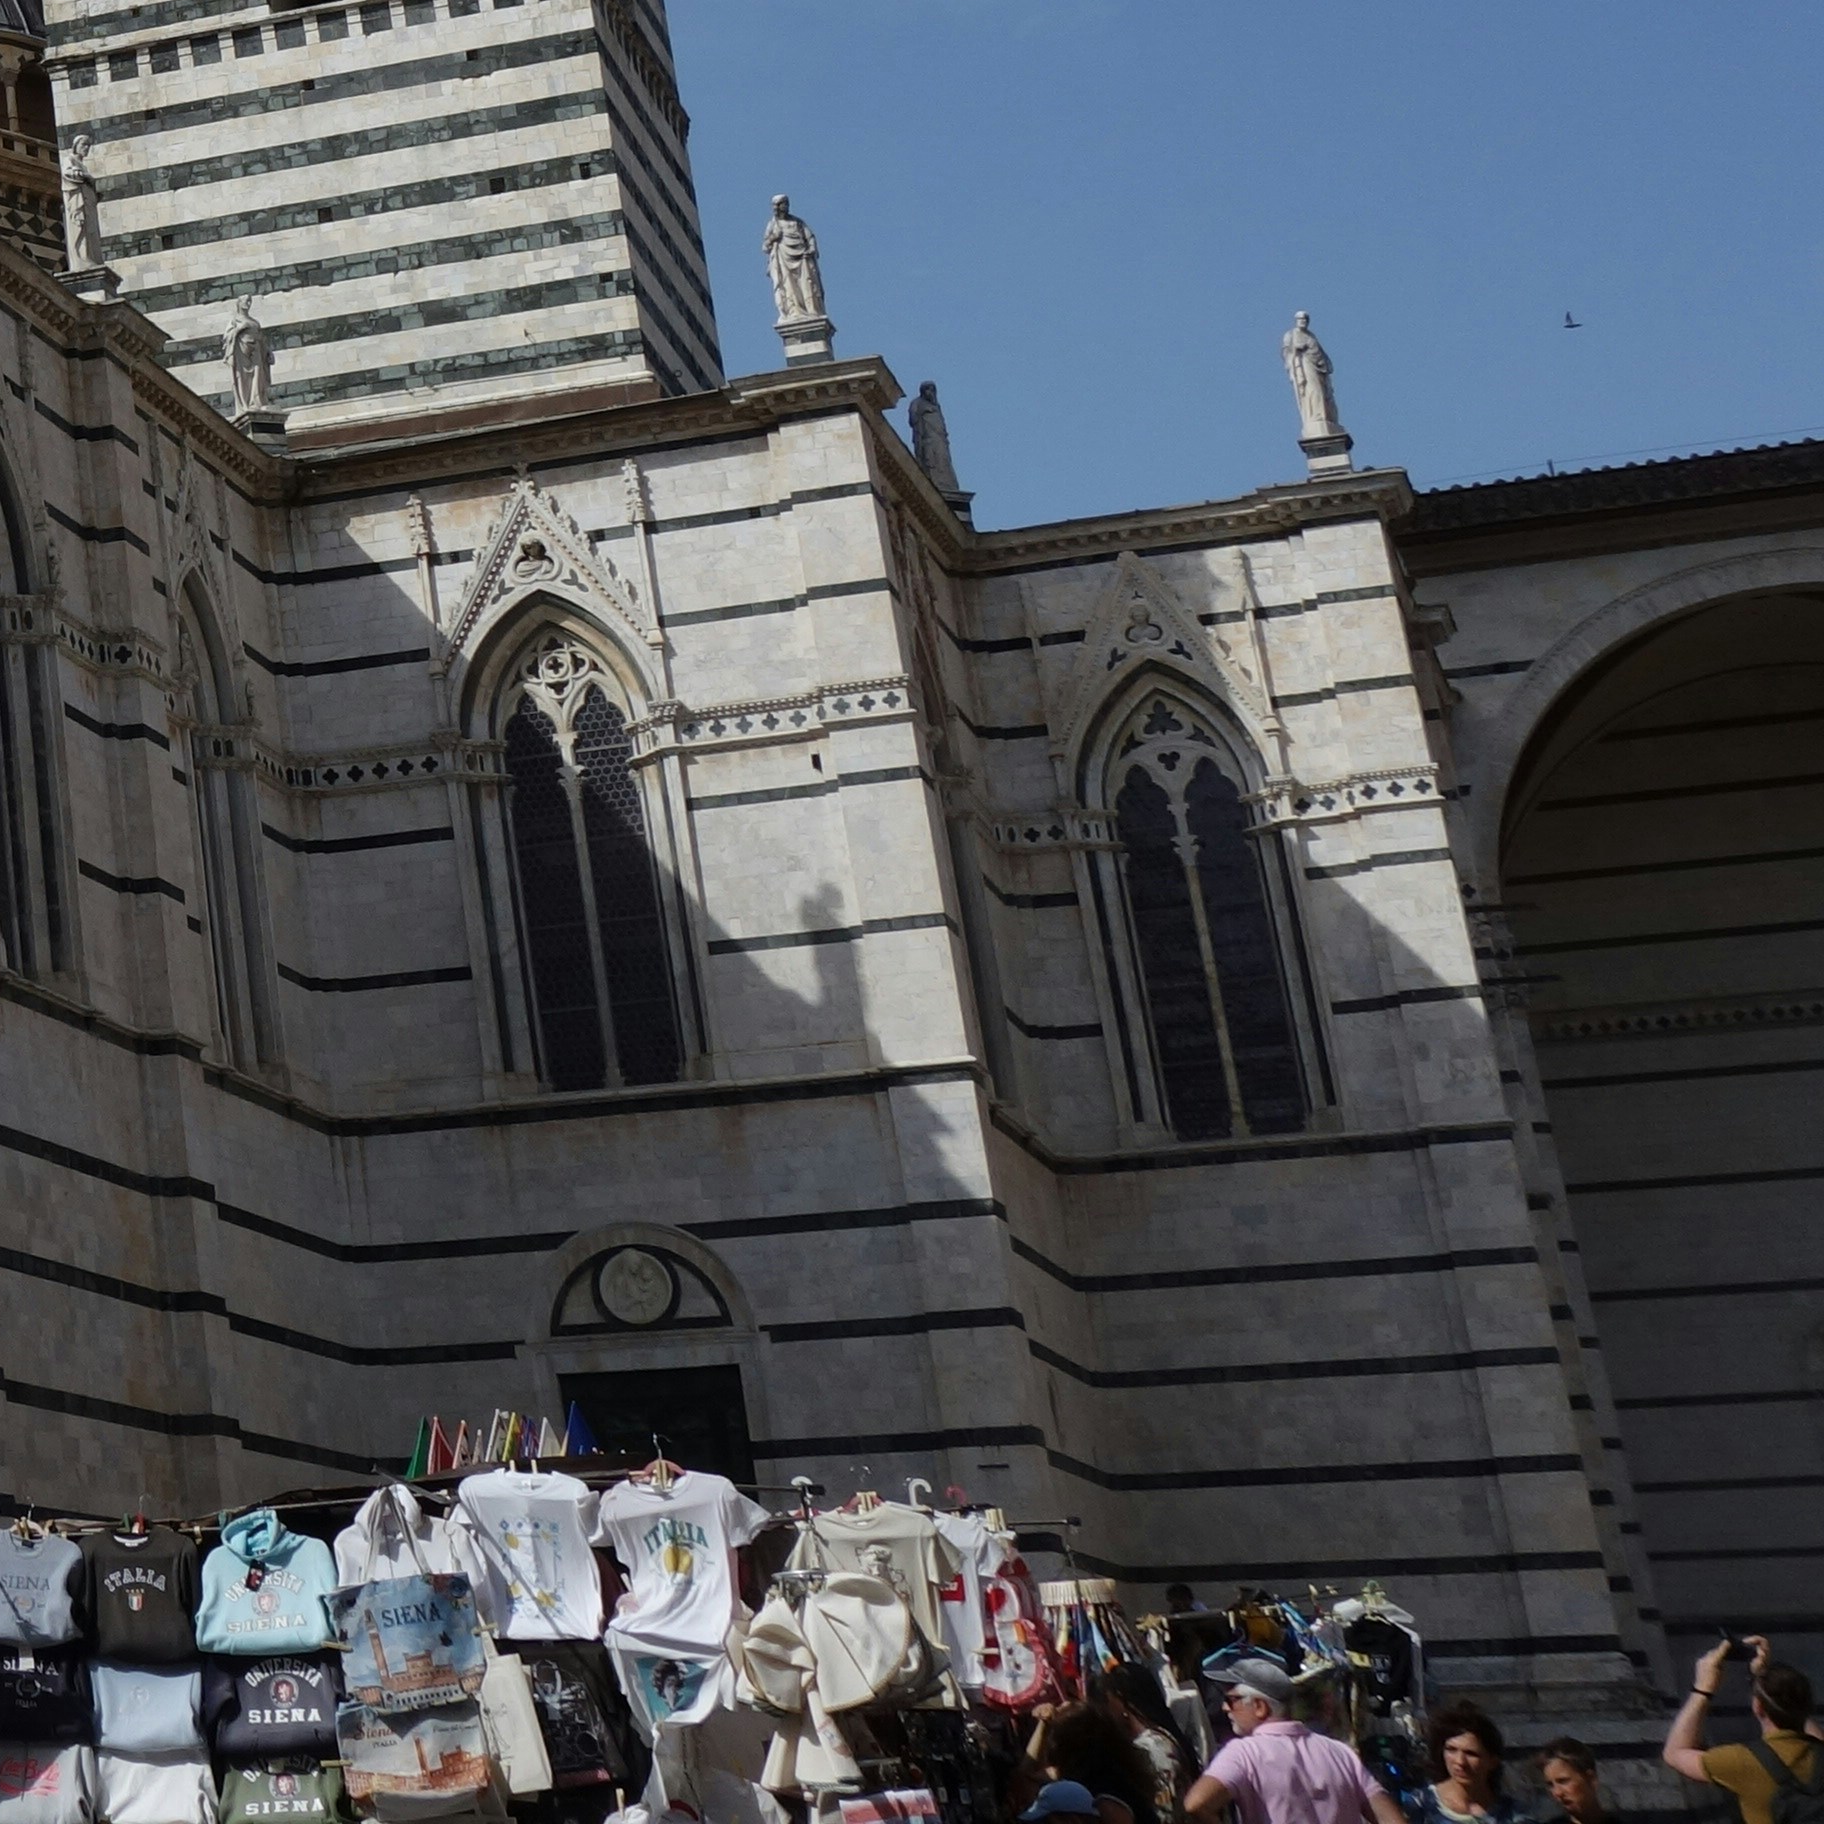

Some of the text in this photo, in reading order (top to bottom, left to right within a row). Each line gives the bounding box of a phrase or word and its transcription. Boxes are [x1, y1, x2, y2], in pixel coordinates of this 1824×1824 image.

[2, 1575, 51, 1591] SIENA
[104, 1567, 167, 1593] ITALIA
[227, 1613, 307, 1633] SIENA
[382, 1602, 443, 1628] SIENA
[3, 1656, 60, 1676] SINA
[248, 1708, 321, 1724] SIENA
[245, 1798, 325, 1816] SIENA
